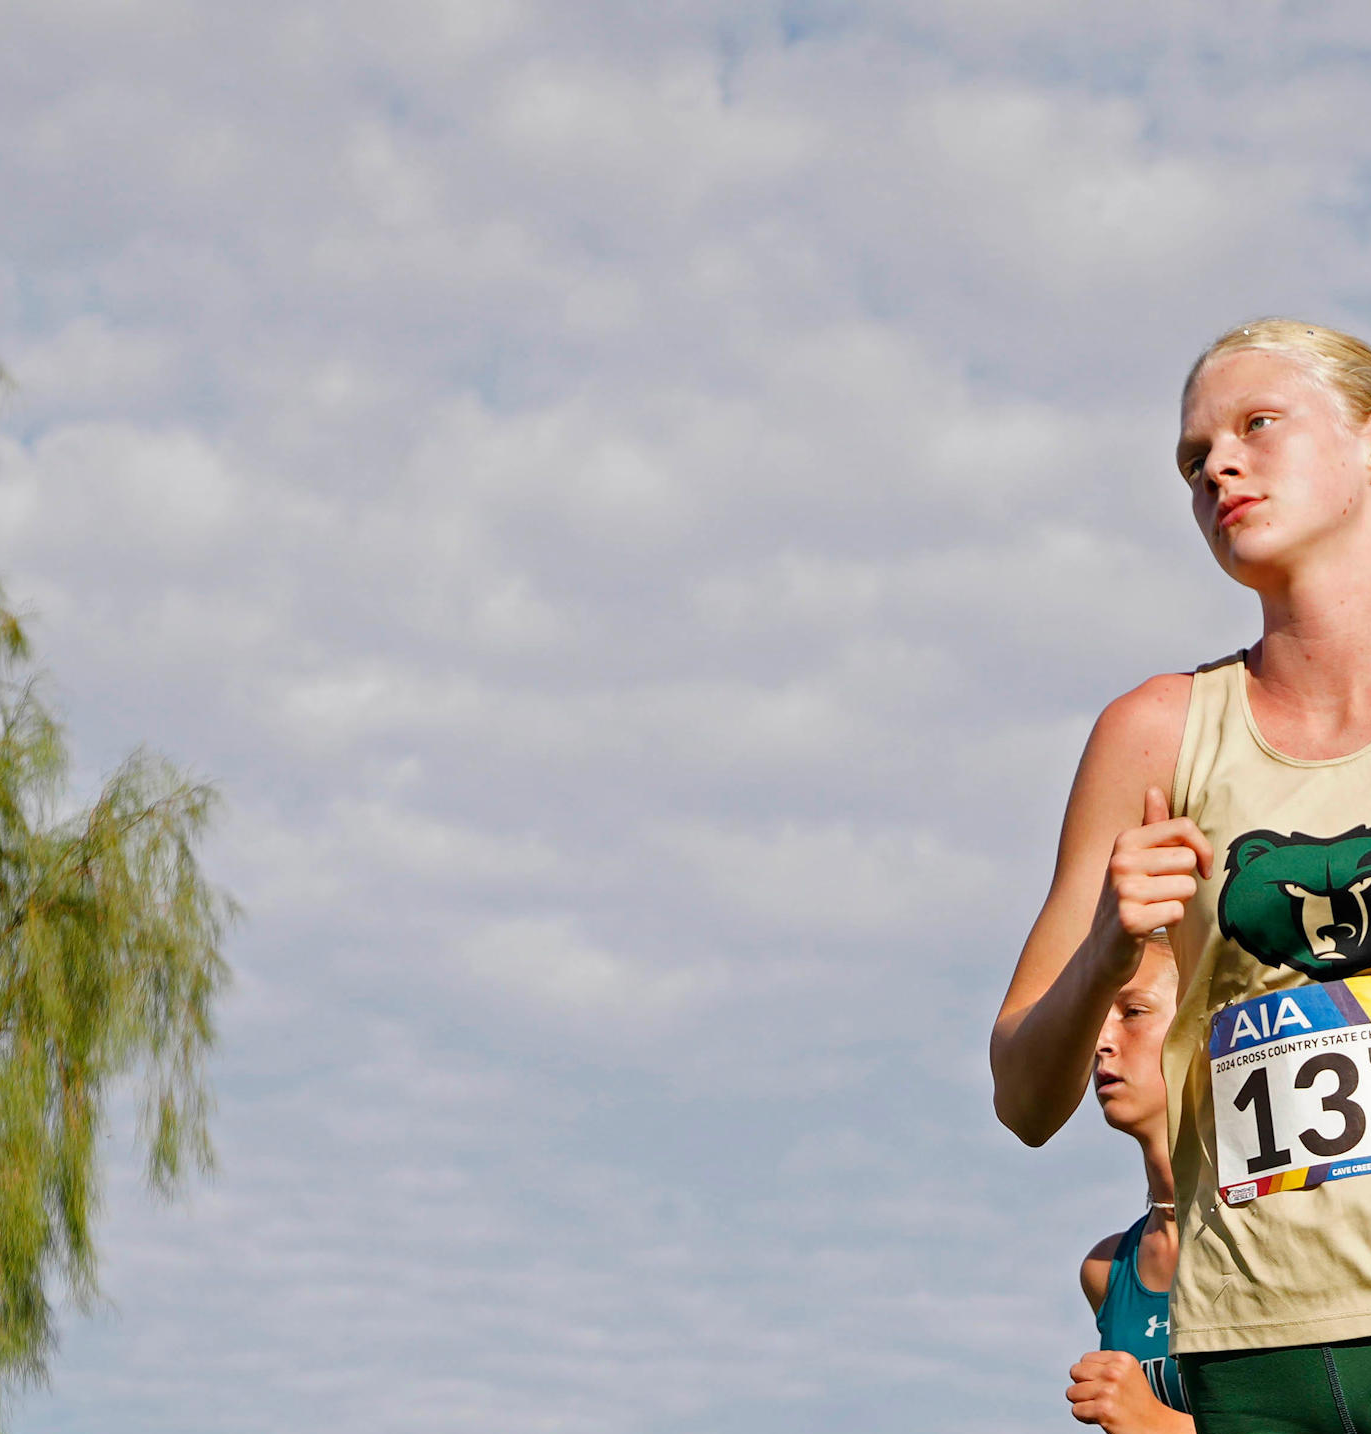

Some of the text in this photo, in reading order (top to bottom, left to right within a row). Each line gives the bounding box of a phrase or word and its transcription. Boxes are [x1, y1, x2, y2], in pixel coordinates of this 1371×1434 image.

[1229, 996, 1313, 1048] AIA
[1216, 1060, 1235, 1074] 2024
[1236, 1050, 1266, 1067] CROSS
[1268, 1037, 1319, 1057] COUNTRY
[1321, 1031, 1358, 1047] STATE
[1332, 1165, 1352, 1177] CAVE
